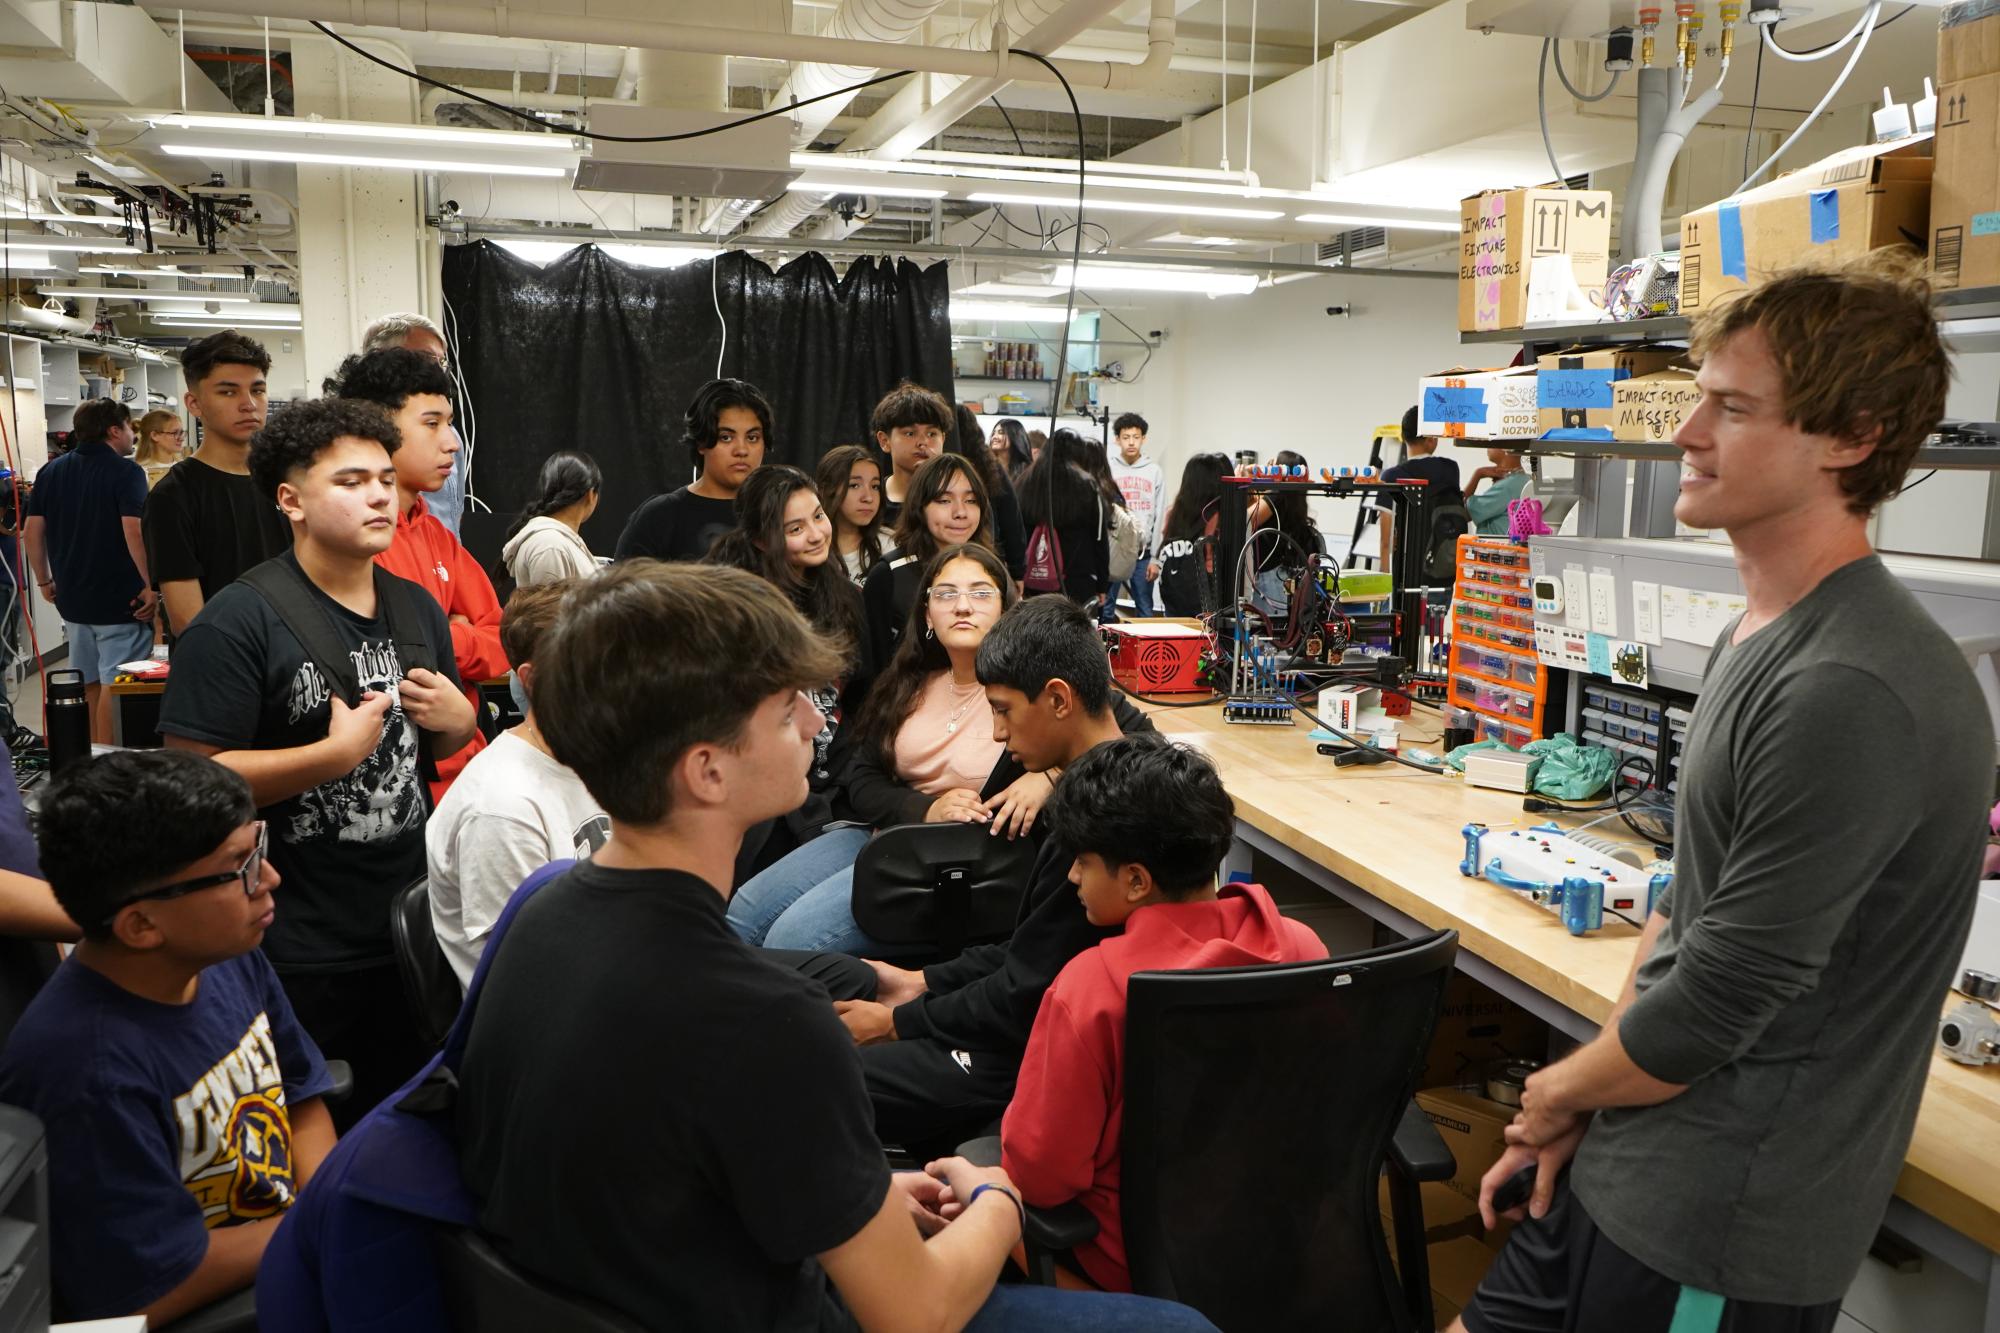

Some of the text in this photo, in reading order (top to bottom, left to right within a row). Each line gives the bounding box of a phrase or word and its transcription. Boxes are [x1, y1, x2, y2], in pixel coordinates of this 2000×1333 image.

[1463, 214, 1507, 234] IMPACT
[1464, 238, 1506, 256] FIXTURE
[1461, 261, 1520, 280] ELECTRONICS
[1617, 389, 1656, 405] IMPACT
[1503, 415, 1529, 424] GOLD
[1619, 409, 1682, 427] MASSES
[1443, 1000, 1503, 1017] NIVERSAL
